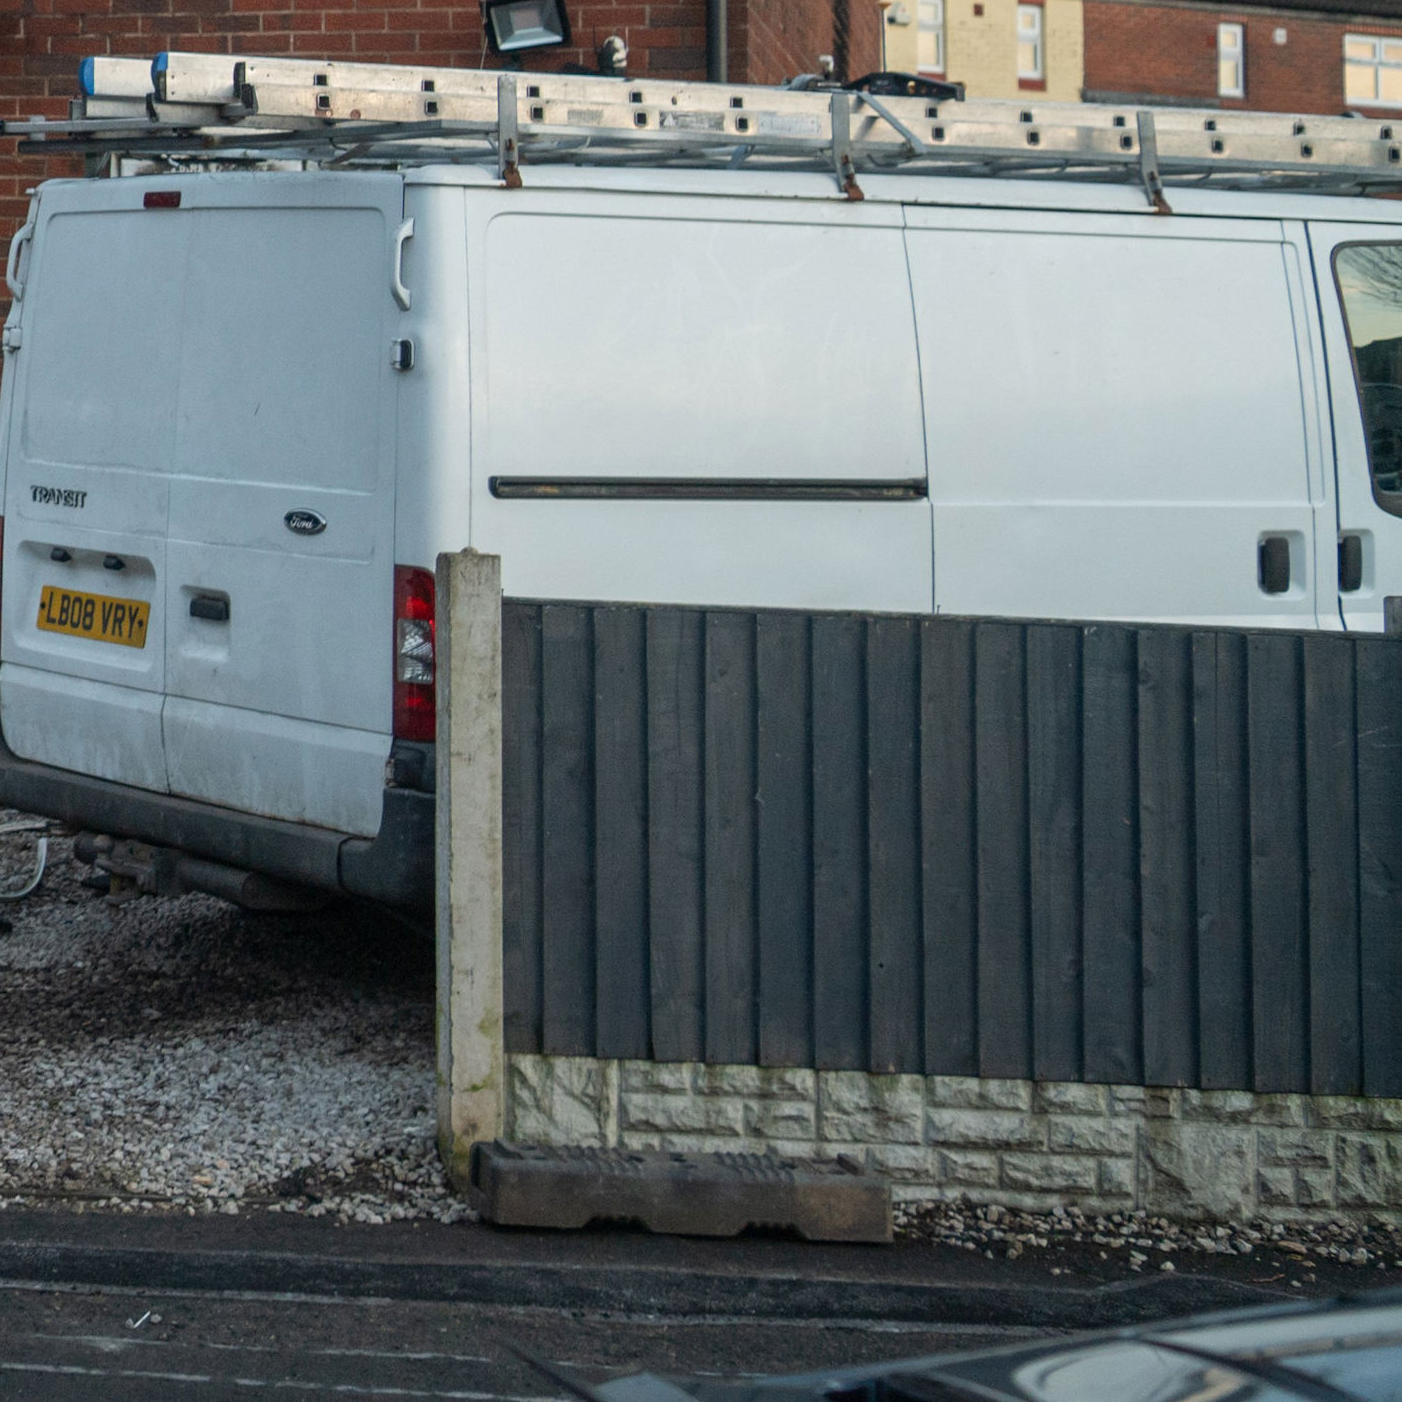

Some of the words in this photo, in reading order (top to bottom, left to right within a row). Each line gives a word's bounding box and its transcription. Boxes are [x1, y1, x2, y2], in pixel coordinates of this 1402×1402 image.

[30, 485, 88, 508] TRANSIT
[290, 512, 315, 529] Ford
[46, 591, 96, 631] LB08
[101, 601, 140, 638] VRY
